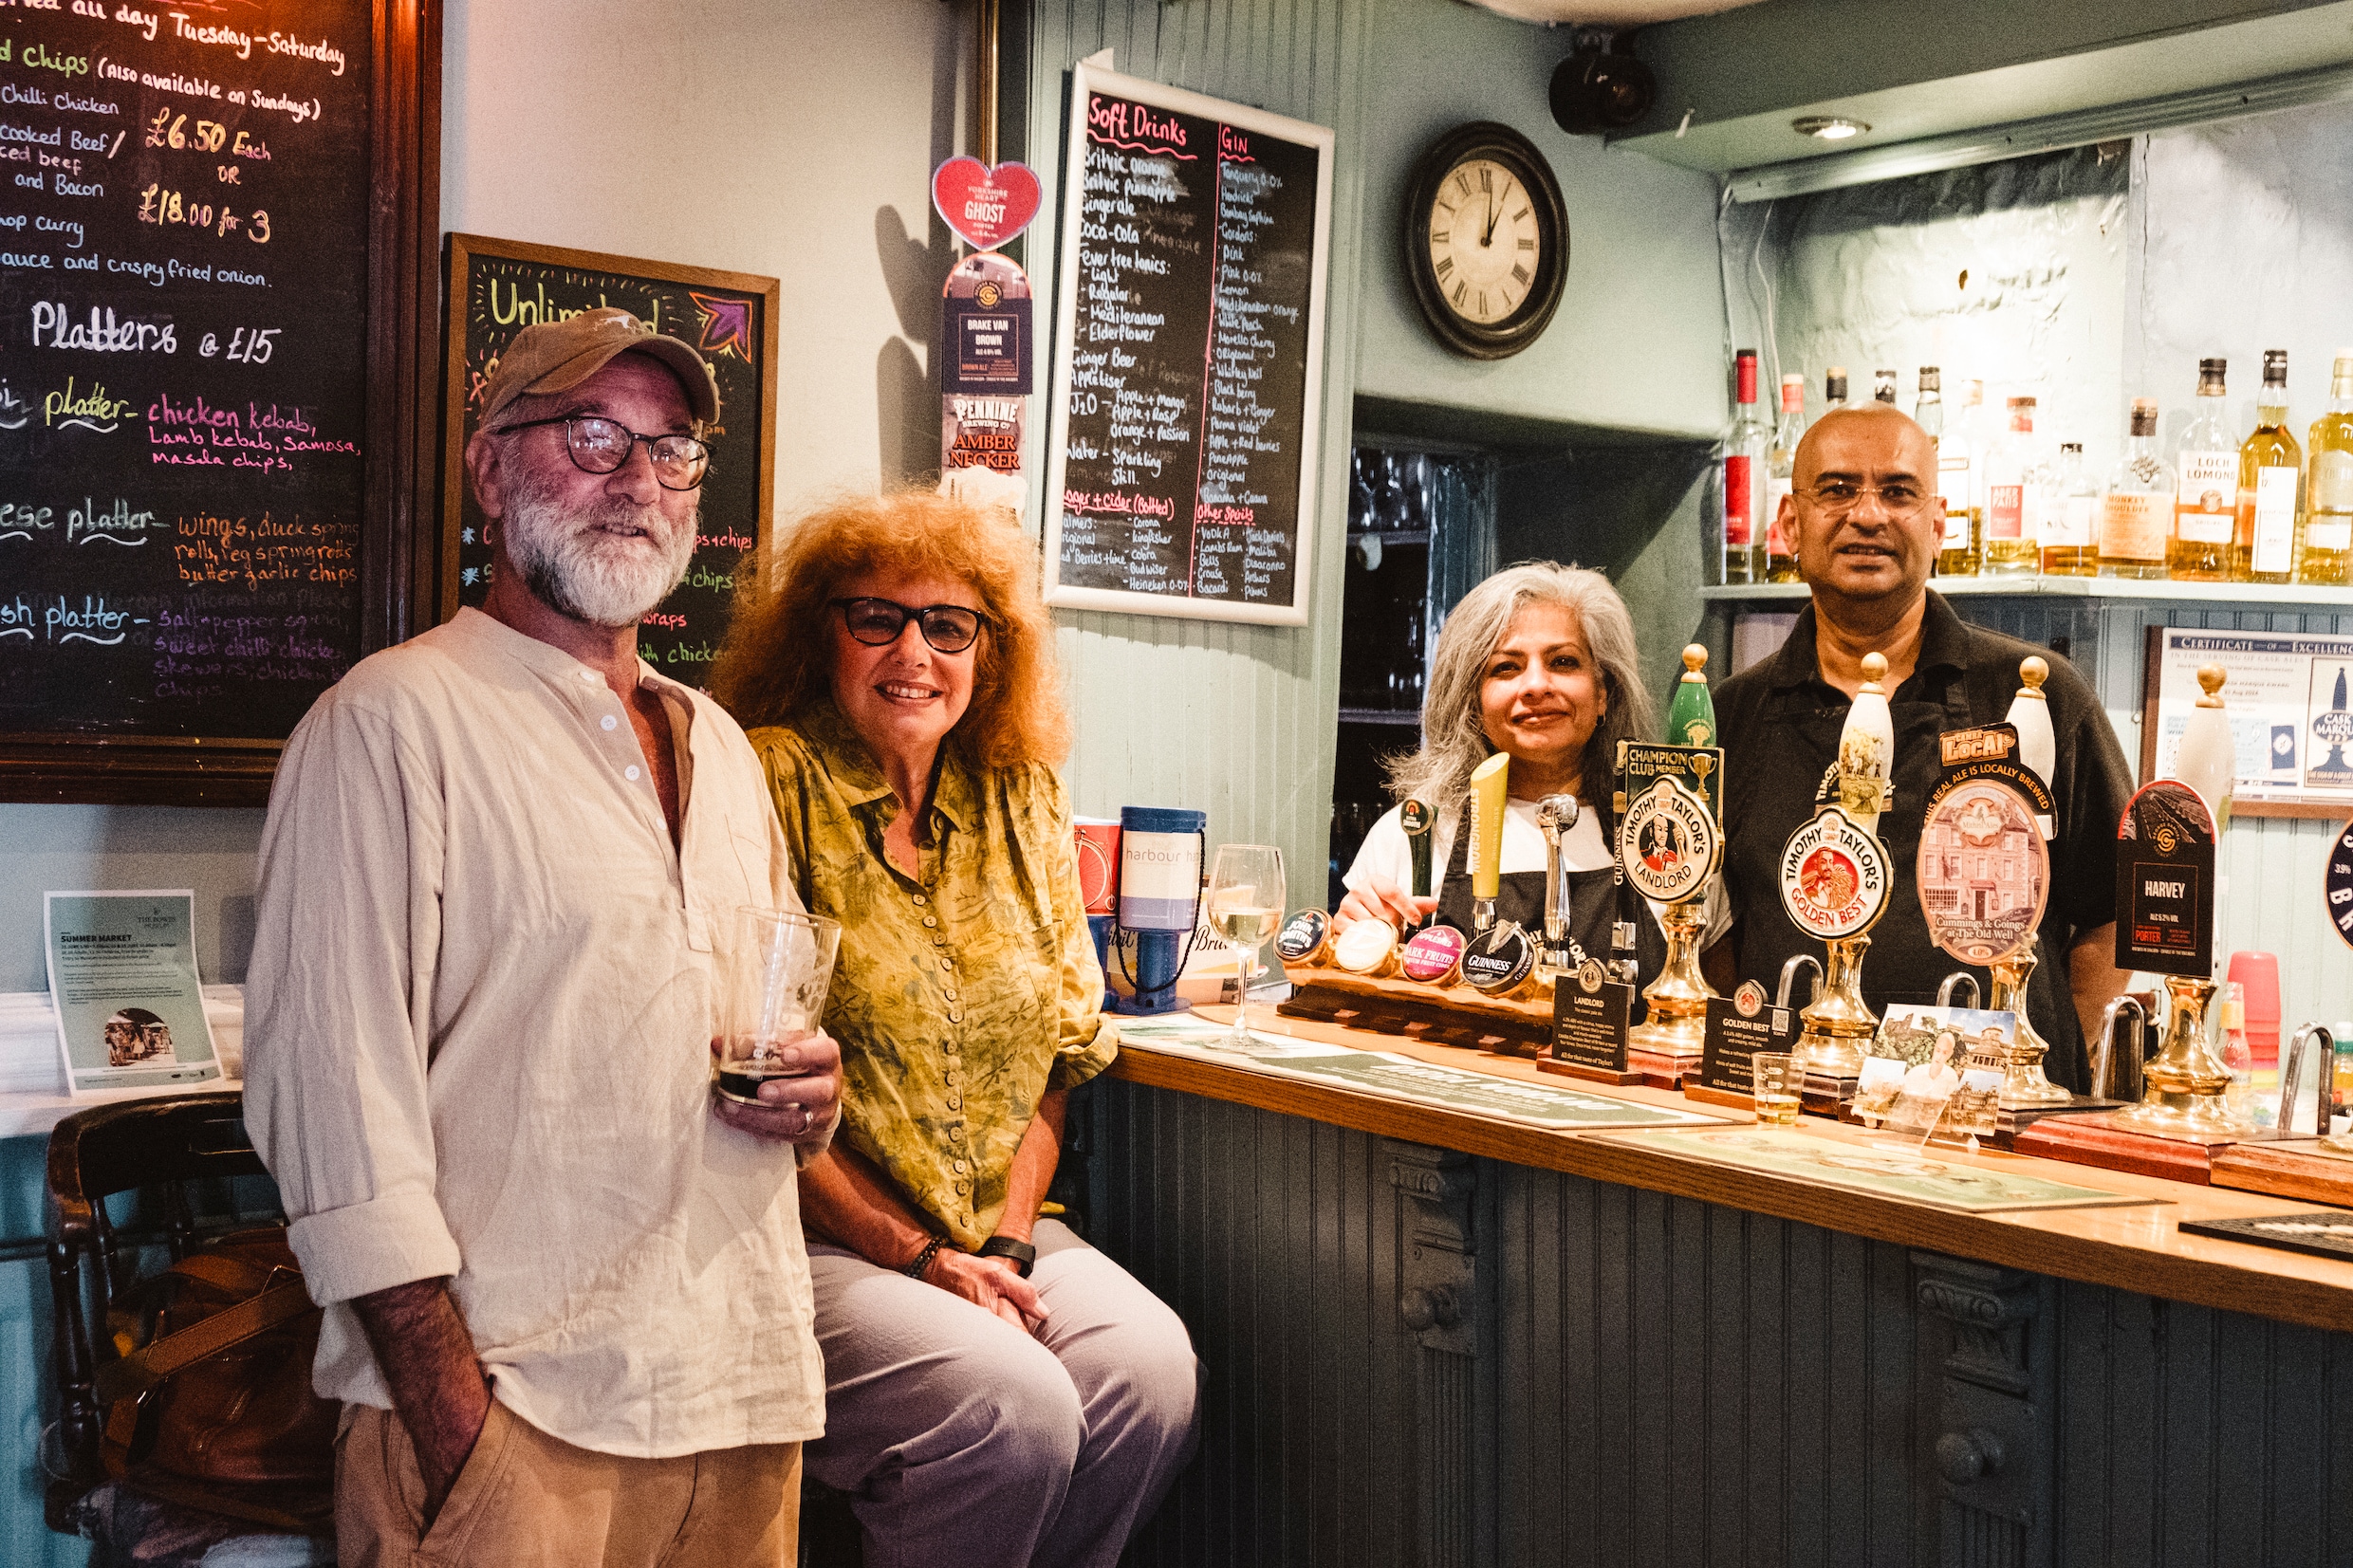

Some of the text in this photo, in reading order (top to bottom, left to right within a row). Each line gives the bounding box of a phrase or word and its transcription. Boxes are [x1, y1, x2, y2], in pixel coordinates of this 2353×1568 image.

[116, 7, 157, 40] day
[142, 73, 221, 100] available
[228, 90, 246, 104] on
[145, 107, 226, 153] £6.50
[1089, 98, 1186, 146] Soft Drinks
[39, 149, 83, 175] beef
[15, 171, 104, 197] and Bacon
[138, 183, 271, 244] £18.00 for 3
[965, 201, 1006, 223] GHOST
[64, 253, 99, 271] and
[168, 261, 211, 283] fried
[1111, 248, 1132, 268] tree
[1089, 284, 1129, 309] Regular
[32, 301, 282, 364] Platters @ £15
[968, 320, 1009, 331] BRAKE VAN
[1089, 323, 1156, 342] Elderflower
[975, 335, 1002, 346] BROWN
[1112, 347, 1137, 368] Beer
[954, 399, 1019, 423] PENNINE
[953, 434, 1016, 451] AMBER
[949, 452, 1020, 469] NECKER
[2198, 457, 2230, 468] LOCH
[2187, 470, 2235, 480] LOMOND
[2107, 494, 2145, 504] MONKEY
[1197, 504, 1222, 519] Other
[258, 511, 306, 537] duck
[178, 563, 239, 582] butter
[309, 563, 358, 588] chips
[2324, 713, 2352, 726] CASK
[1629, 748, 1688, 766] CHAMPION
[1629, 763, 1686, 776] CLUB MEMBER
[1933, 765, 2049, 809] REAL ALE IS LOCALLY BREWED
[1471, 787, 1481, 873] STRONGBOW
[1626, 795, 1704, 855] TIMOTHY TAYLOR'S
[1126, 847, 1181, 862] harbour
[1614, 826, 1624, 886] GUINNESS
[1786, 827, 1877, 890] TIMOTHY TAYLOR'S
[1635, 860, 1692, 889] LANDLORD
[2144, 880, 2185, 899] HARVEY
[1791, 887, 1867, 927] GOLDEN BEST
[1288, 920, 1314, 934] JOHN
[1936, 918, 2026, 932] Cummings & Goings
[1947, 928, 2013, 940] at The Old Well
[2135, 930, 2161, 943] PORTER
[1424, 950, 1454, 964] FRUITS
[1468, 954, 1511, 971] GUINNESS
[1514, 950, 1534, 981] GUINNESS
[1574, 996, 1604, 1008] LANDLORD
[1722, 1018, 1770, 1033] GOLDEN BEST
